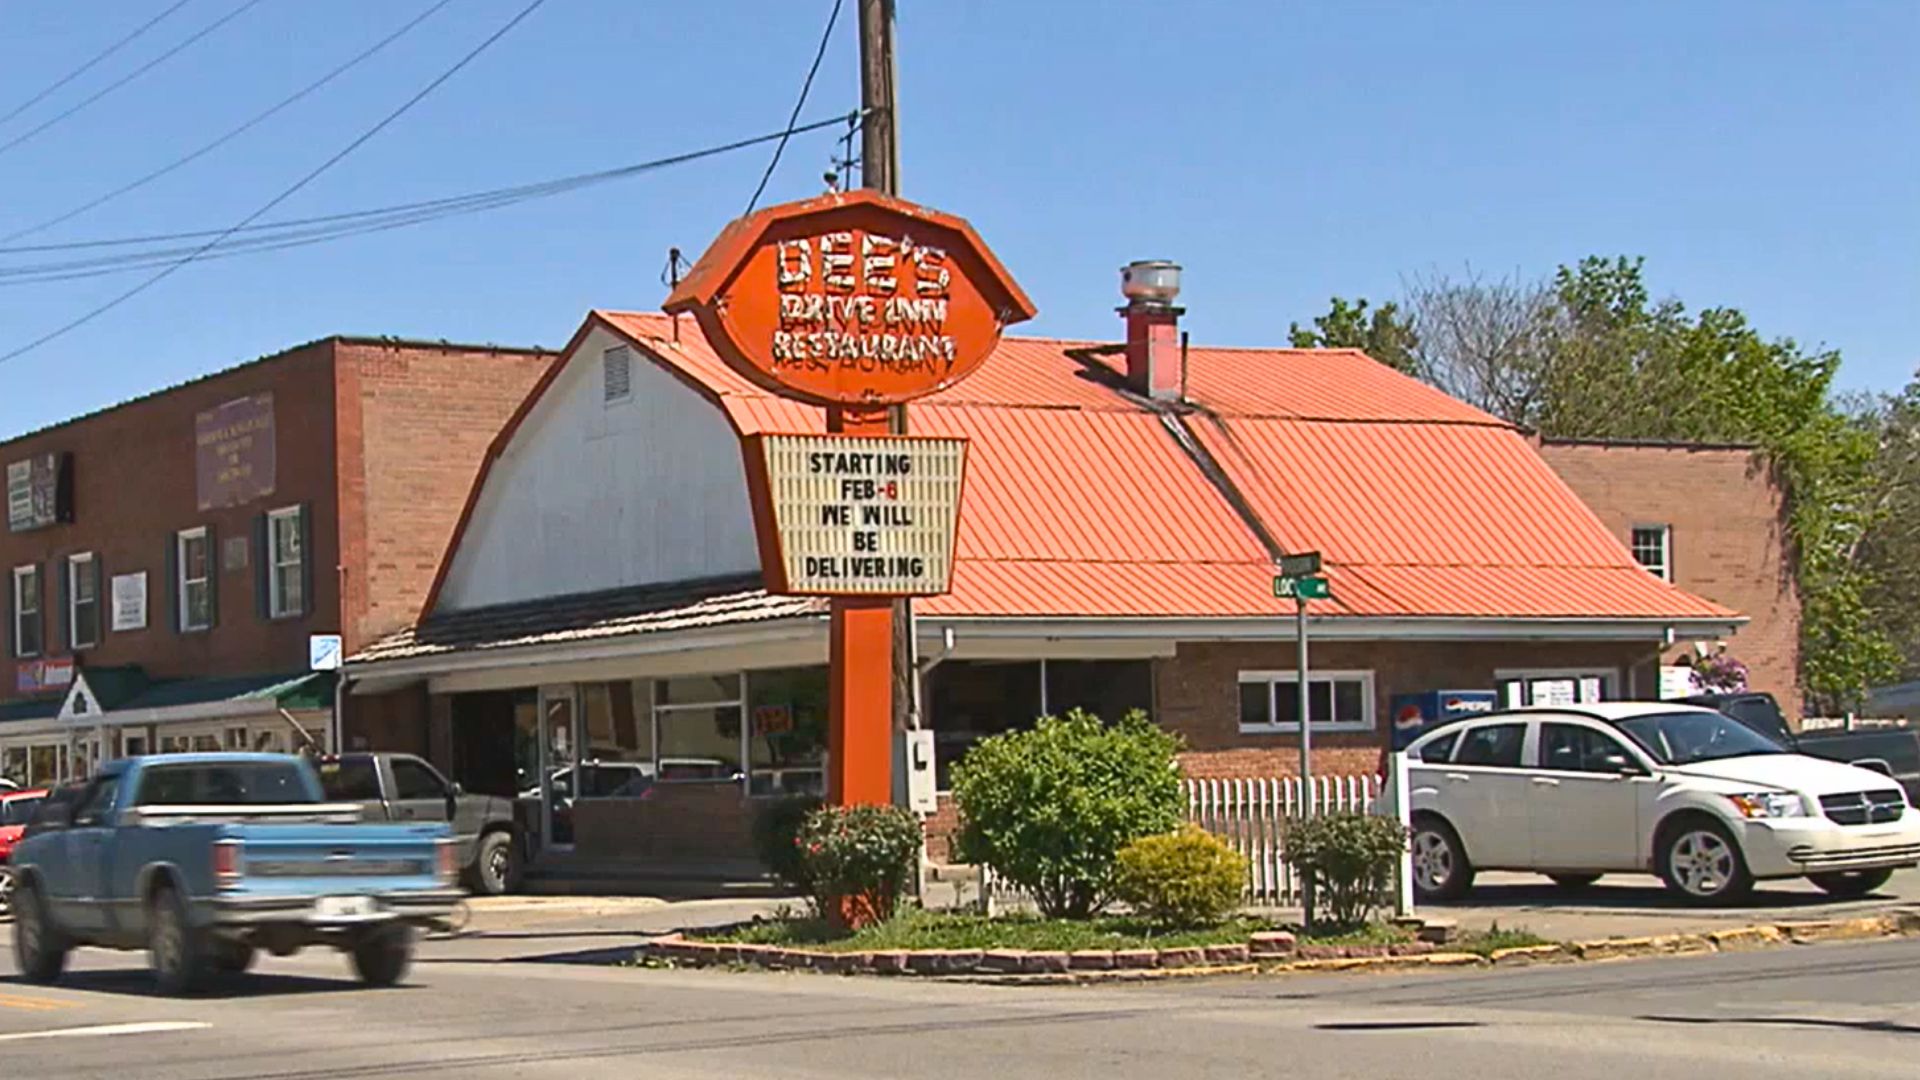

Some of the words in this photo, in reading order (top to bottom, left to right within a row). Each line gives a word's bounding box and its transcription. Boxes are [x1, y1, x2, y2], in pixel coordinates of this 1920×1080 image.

[778, 233, 950, 289] DEE'S
[781, 294, 875, 321] DRIVE
[774, 331, 956, 362] RESTAURANT
[810, 453, 911, 475] STARTING
[841, 479, 898, 500] FEB-6
[822, 505, 850, 526] WE
[864, 505, 913, 526] WILL
[853, 531, 878, 552] BE
[806, 557, 923, 578] DELIVERING
